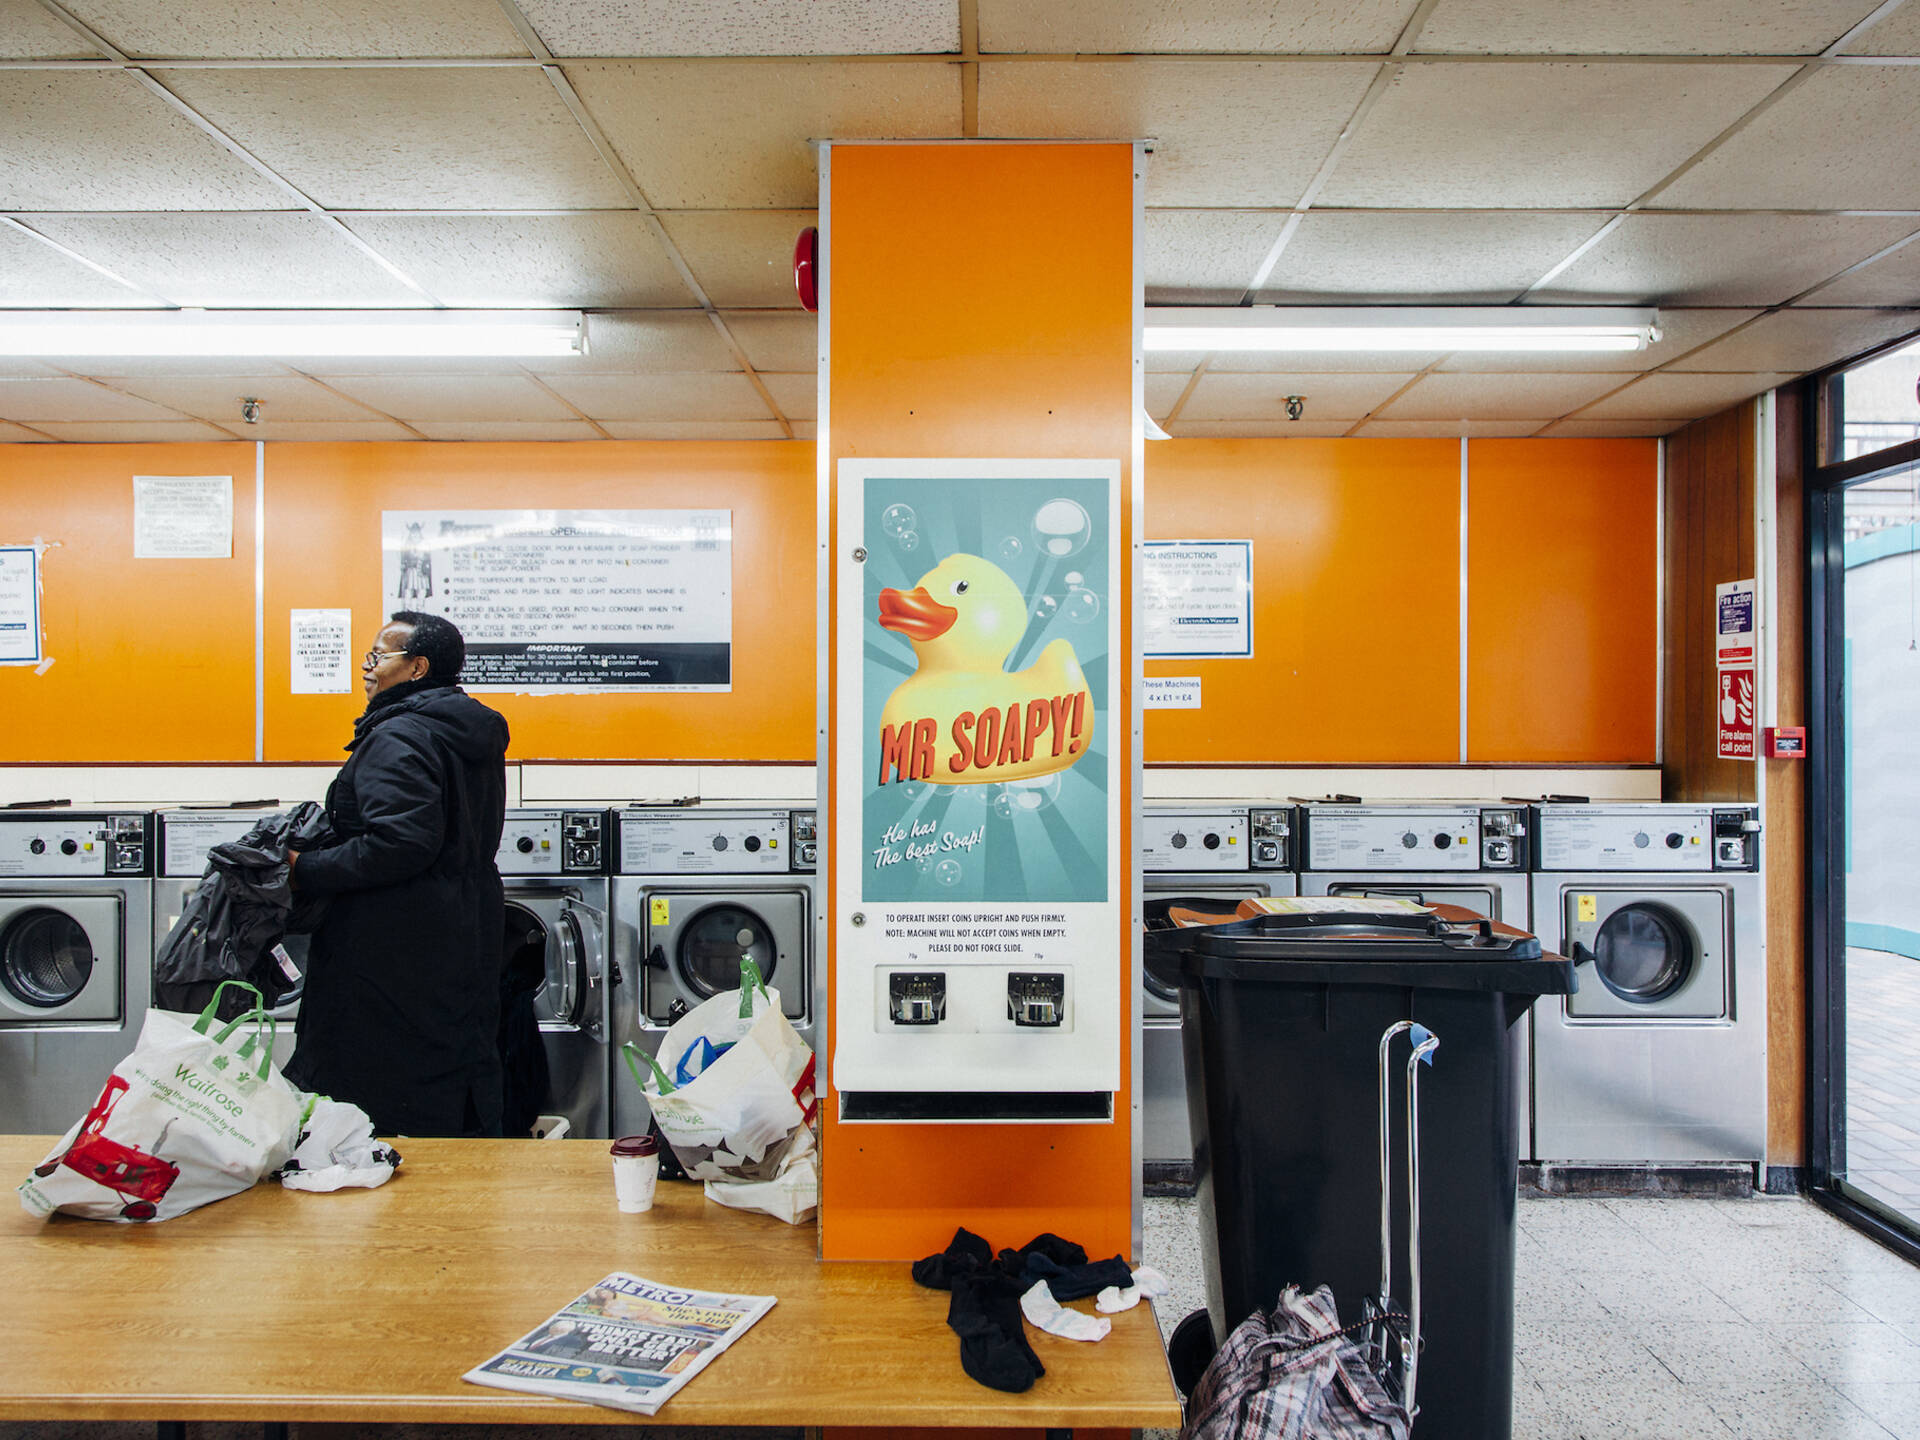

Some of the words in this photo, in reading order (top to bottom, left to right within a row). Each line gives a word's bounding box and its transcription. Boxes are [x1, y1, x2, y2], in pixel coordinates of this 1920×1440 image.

[1158, 551, 1218, 560] INSTRUCTIONS
[1165, 680, 1200, 688] Machines
[879, 717, 938, 786] MR
[949, 691, 1086, 774] SOAPY!
[1721, 729, 1733, 740] Fire
[1733, 731, 1752, 741] alarm
[1721, 742, 1733, 752] call
[1734, 743, 1751, 754] point
[882, 822, 907, 847] He
[911, 818, 938, 838] has
[873, 848, 901, 869] The
[905, 841, 939, 861] best
[940, 825, 986, 853] Soap!
[886, 914, 895, 923] TO
[896, 914, 925, 923] OPERATE
[927, 914, 949, 923] INSERT
[951, 914, 972, 923] COINS
[973, 914, 1003, 923] UPRIGHT
[1005, 914, 1020, 923] AND
[1021, 914, 1039, 923] PUSH
[1041, 914, 1066, 923] FIRMLY.
[885, 929, 905, 937] NOTE:
[907, 929, 937, 937] MACHINE
[939, 929, 955, 937] WILL
[957, 929, 970, 937] NOT
[973, 929, 996, 937] ACCEPT
[998, 929, 1019, 937] COINS
[1021, 929, 1041, 937] WHEN
[1043, 929, 1066, 937] EMPTY.
[928, 944, 951, 952] PLEASE
[953, 944, 964, 952] DO
[965, 944, 979, 952] NOT
[981, 944, 1001, 952] FORCE
[1004, 944, 1023, 952] SLIDE.
[175, 1064, 243, 1117] Waitrose
[600, 1277, 689, 1305] METRO
[587, 1333, 641, 1347] ONLY
[643, 1340, 685, 1353] GET
[650, 1334, 693, 1346] CAN
